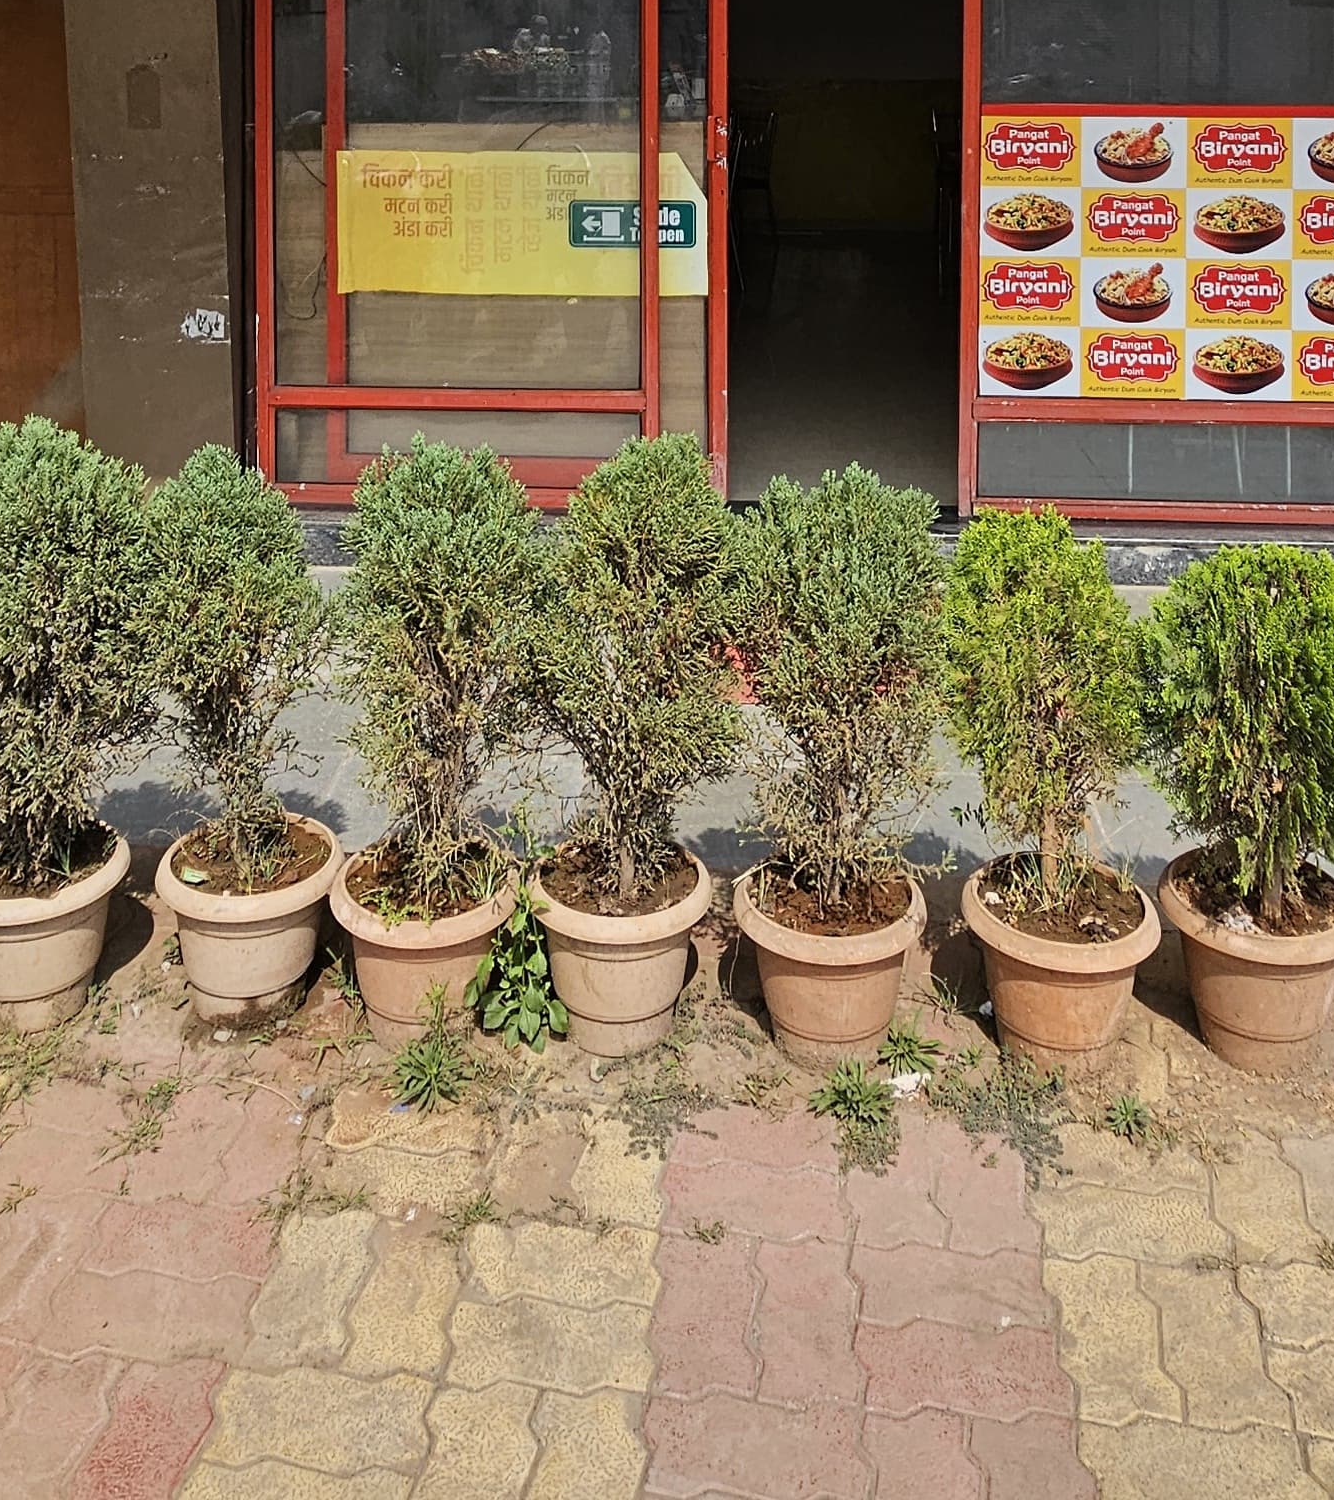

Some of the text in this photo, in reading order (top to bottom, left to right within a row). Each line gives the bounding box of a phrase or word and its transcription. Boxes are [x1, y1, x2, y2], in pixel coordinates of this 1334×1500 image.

[1009, 130, 1049, 140] Pangat
[1219, 130, 1260, 142] Pangat
[991, 139, 1067, 155] Biryani
[1200, 141, 1279, 157] Biryani
[1017, 156, 1041, 164] Point
[1227, 158, 1251, 166] Point
[545, 165, 590, 187] चिकन
[383, 193, 454, 214] मटन करी
[1113, 200, 1154, 212] Pangat
[633, 206, 681, 226] Sde
[1095, 210, 1173, 226] Biryani
[393, 216, 453, 238] अंडा करी
[1121, 228, 1145, 236] Point
[1008, 268, 1049, 280] Pangat
[1218, 272, 1259, 283] Pangat
[989, 279, 1067, 295] Biryani
[1199, 282, 1278, 298] Biryani
[1016, 296, 1040, 304] Point
[1226, 299, 1251, 307] Point
[1113, 340, 1153, 352] Pangat
[1093, 350, 1171, 366] Biryani
[1121, 367, 1145, 376] Point
